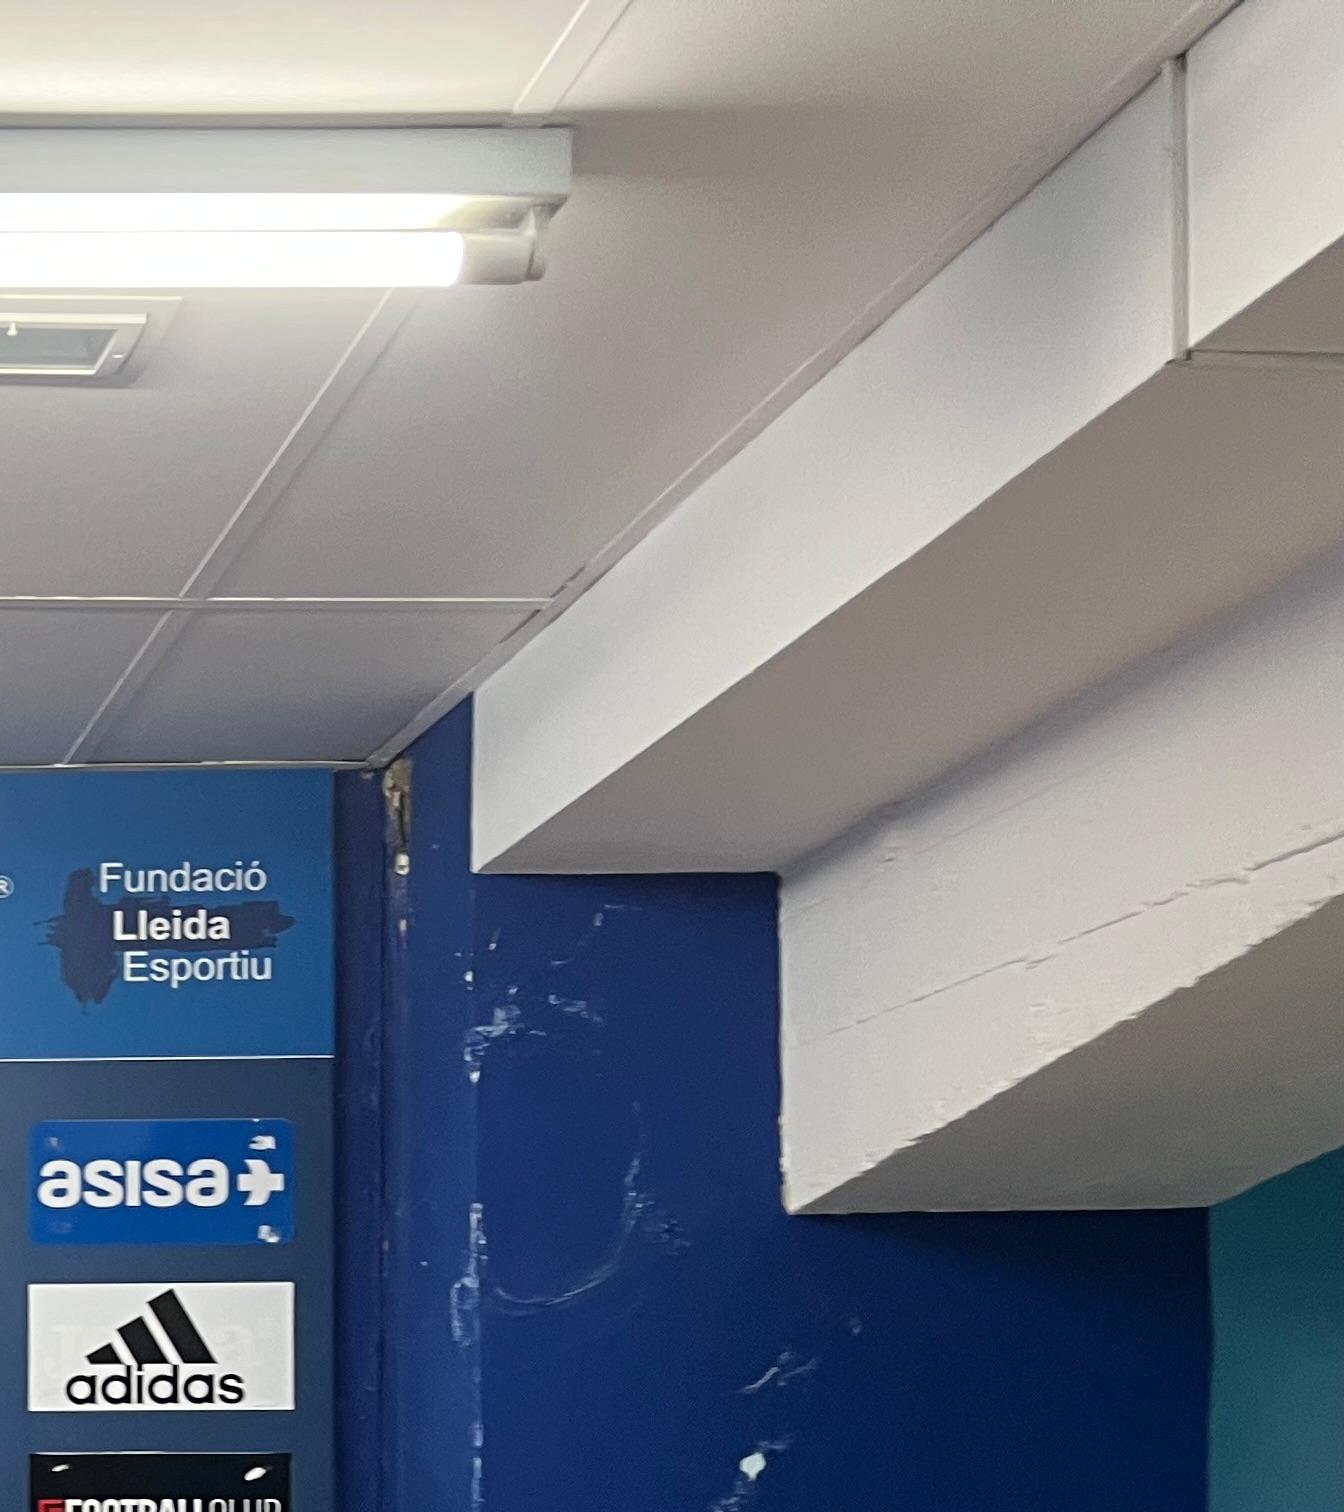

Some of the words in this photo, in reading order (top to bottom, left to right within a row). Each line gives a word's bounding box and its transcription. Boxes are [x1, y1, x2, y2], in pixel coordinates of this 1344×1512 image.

[101, 861, 266, 892] Fundació
[114, 910, 229, 940] Lleida
[124, 950, 271, 988] Esportiu
[38, 1159, 228, 1207] asisa
[66, 1365, 244, 1405] adidas
